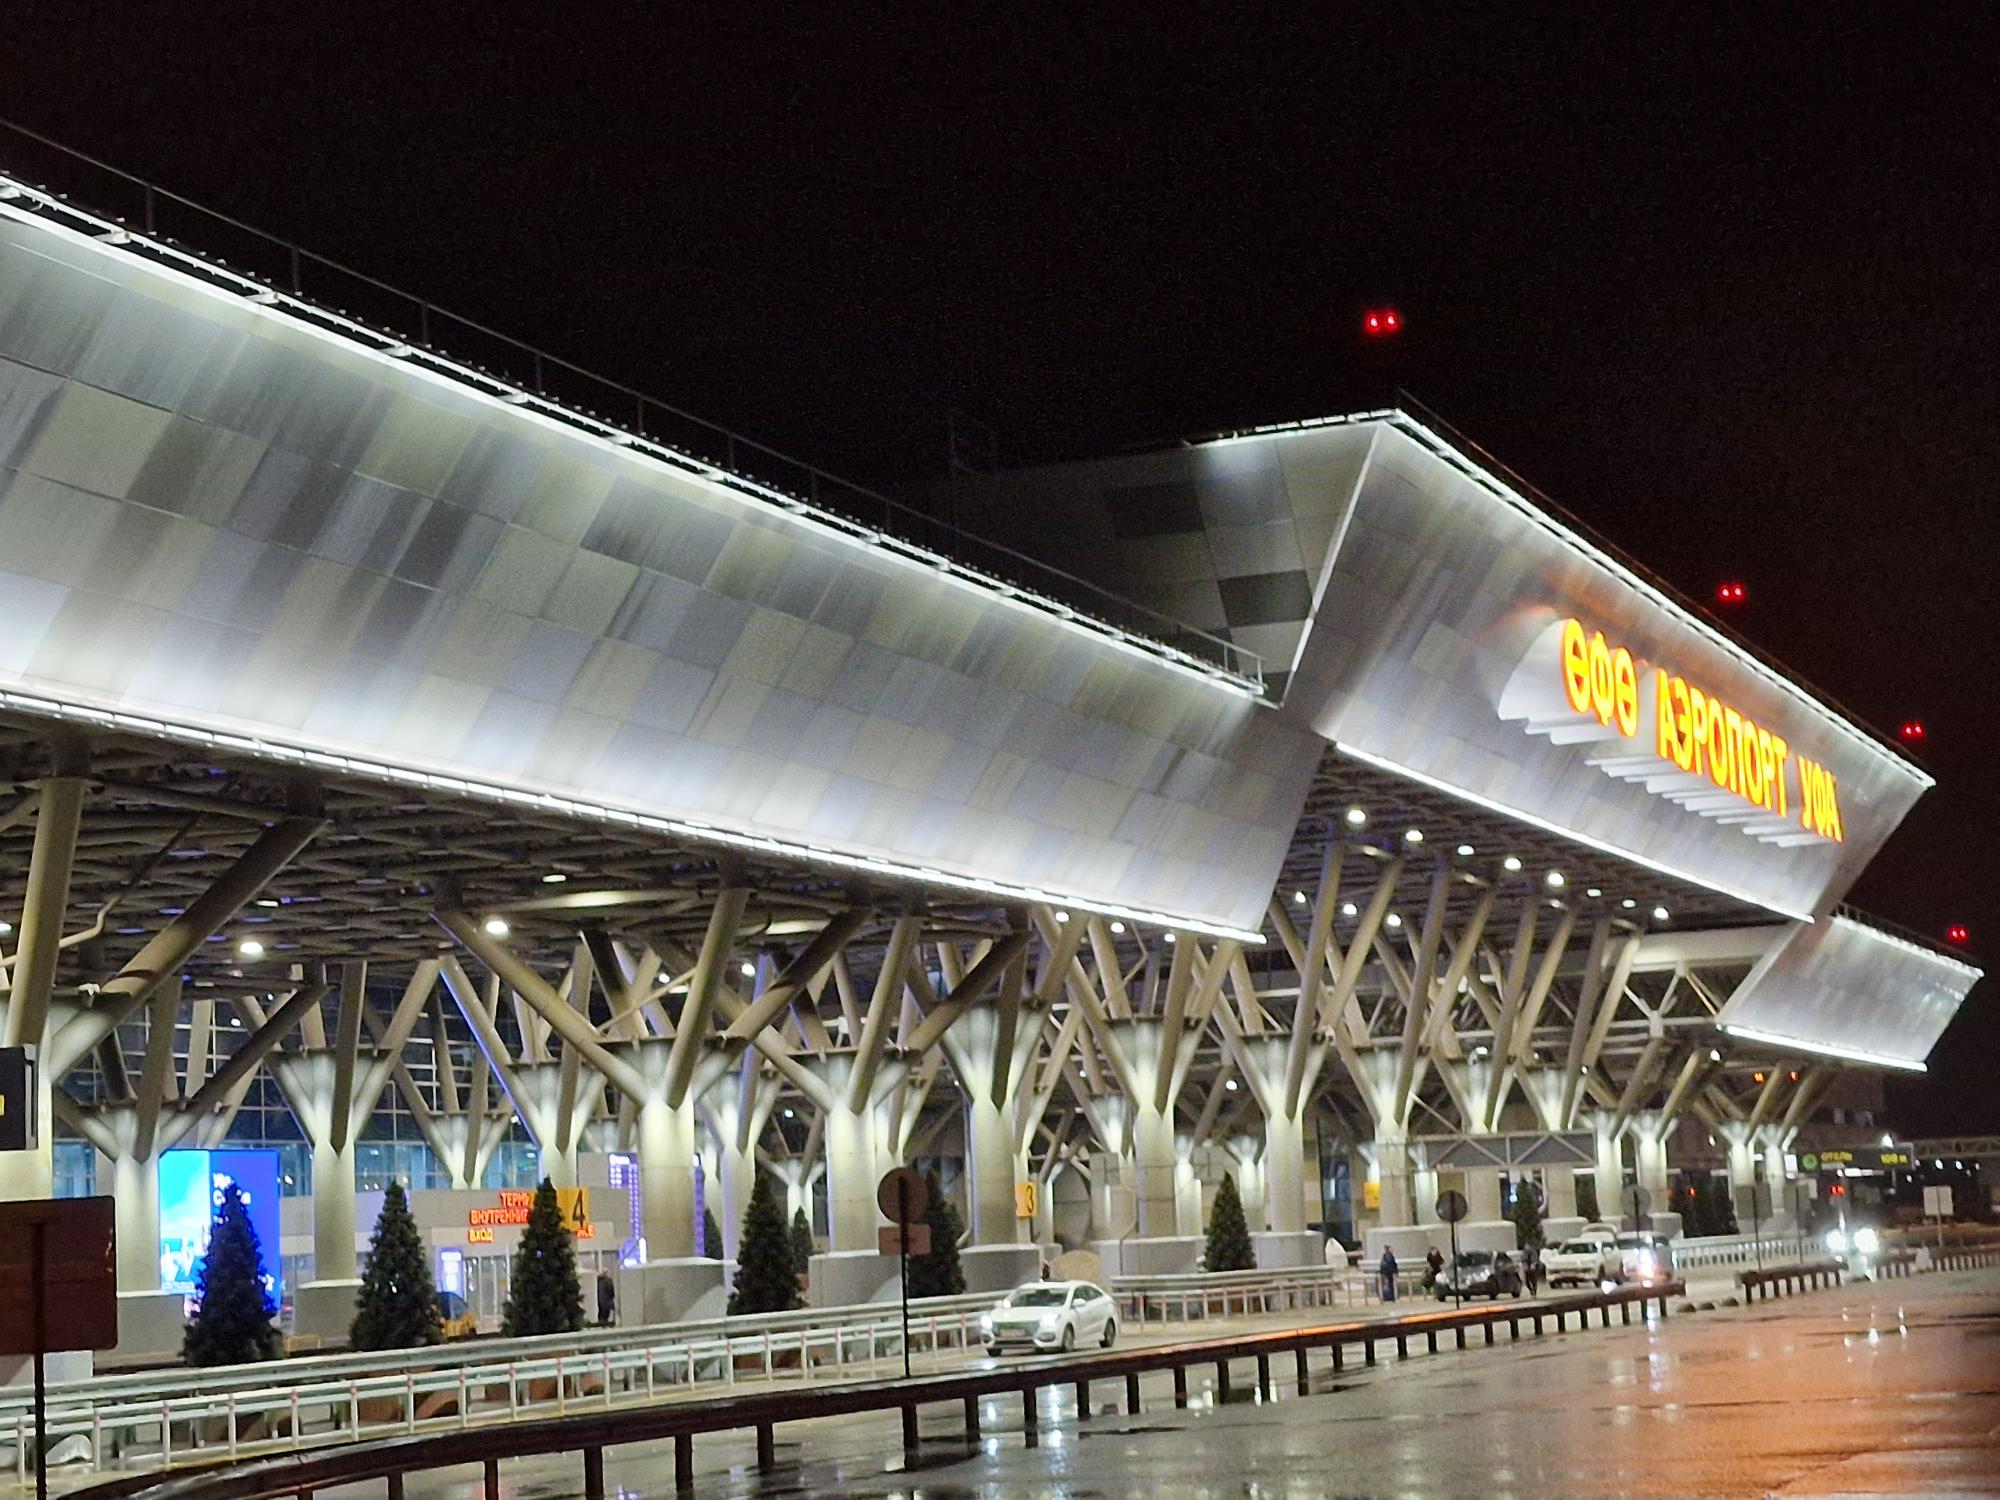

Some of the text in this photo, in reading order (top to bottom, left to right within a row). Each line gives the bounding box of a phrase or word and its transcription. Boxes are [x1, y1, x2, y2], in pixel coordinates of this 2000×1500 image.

[1655, 667, 1789, 818] АЭРОПОРТ
[1798, 755, 1844, 843] УФА
[501, 1191, 530, 1208] ТЕРМИ
[572, 1189, 586, 1229] 4
[1026, 1185, 1035, 1214] 3
[469, 1228, 494, 1242] ВХОД
